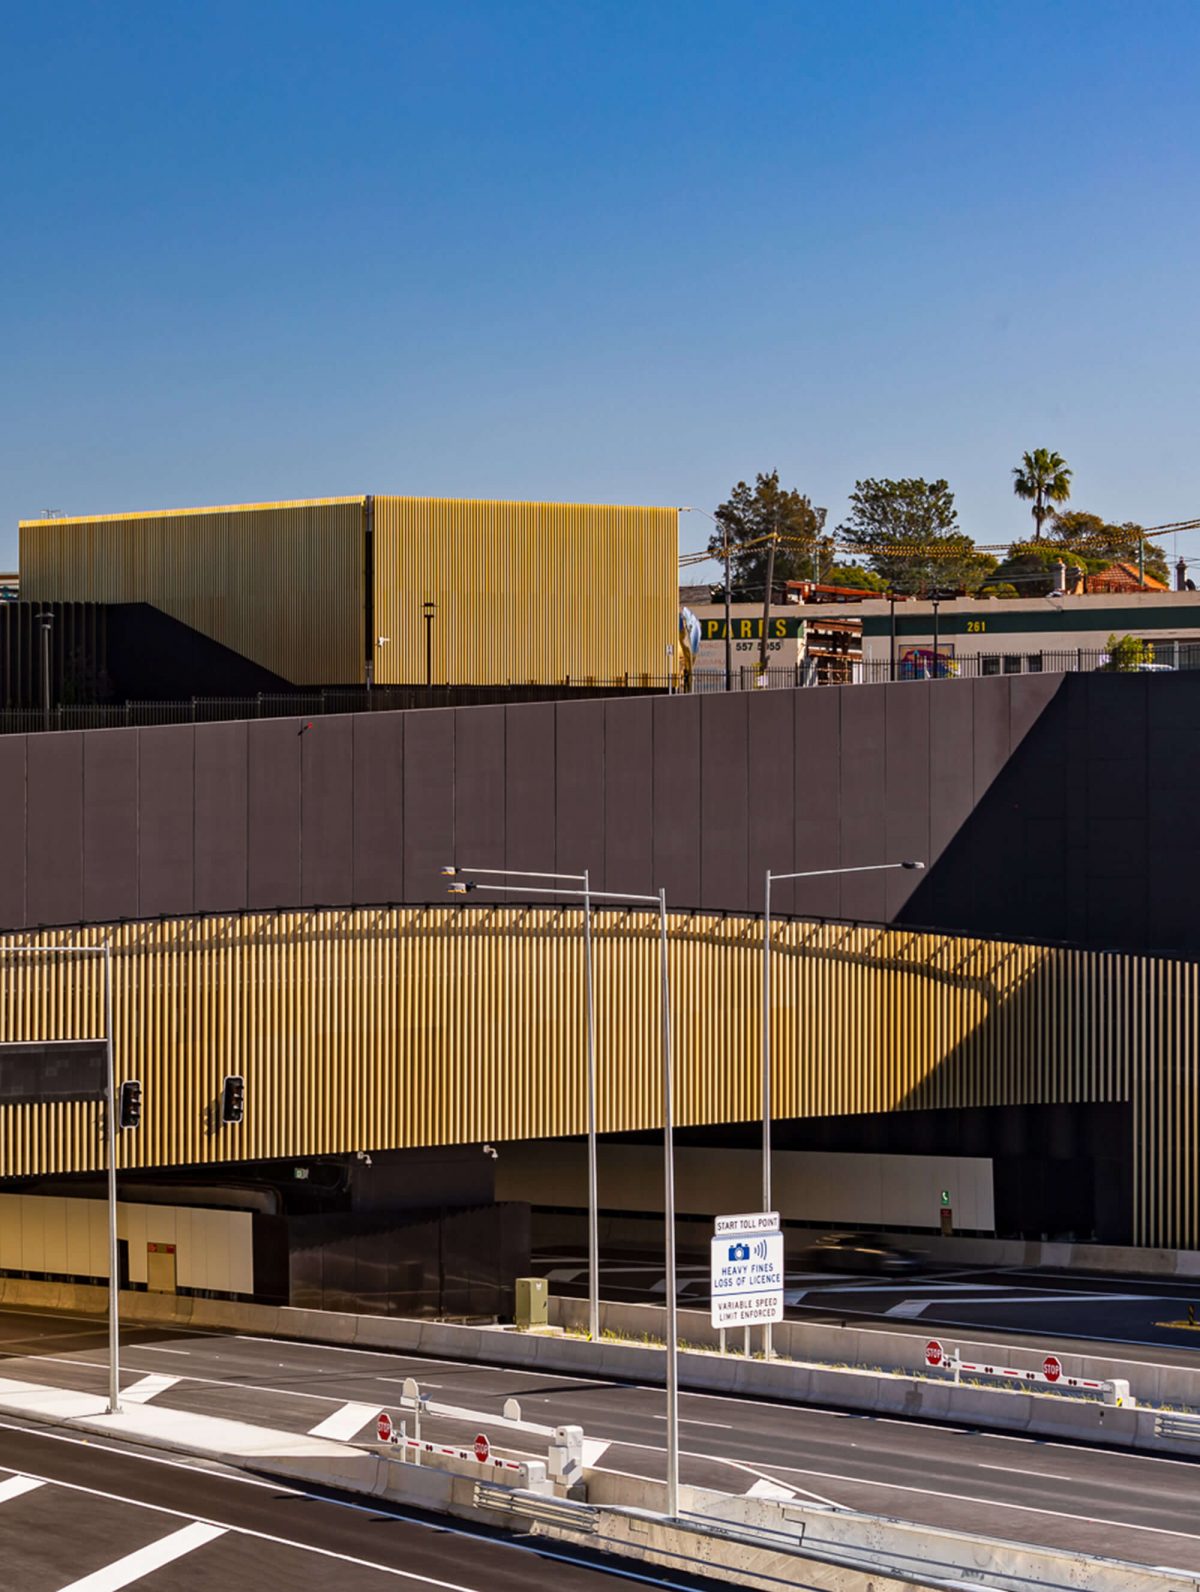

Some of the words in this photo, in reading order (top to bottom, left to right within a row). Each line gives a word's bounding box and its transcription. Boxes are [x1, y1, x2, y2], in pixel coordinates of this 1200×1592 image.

[967, 621, 986, 632] 261
[736, 642, 753, 651] 557
[757, 642, 781, 651] 555
[717, 1220, 738, 1231] START
[740, 1219, 756, 1229] TOLL
[758, 1217, 777, 1227] POINT
[722, 1264, 748, 1276] HEAVY
[751, 1262, 774, 1273] FINES
[714, 1277, 733, 1288] LOSS
[736, 1276, 746, 1286] OF
[749, 1273, 781, 1286] LICENCE
[717, 1299, 753, 1310] VARIABLE
[755, 1297, 777, 1308] SPEED
[719, 1311, 738, 1322] LIMIT
[740, 1308, 777, 1320] ENFORCED
[926, 1347, 942, 1359] STOP
[1043, 1363, 1059, 1375] STOP
[377, 1421, 391, 1433] STOP
[474, 1442, 488, 1454] STOP
